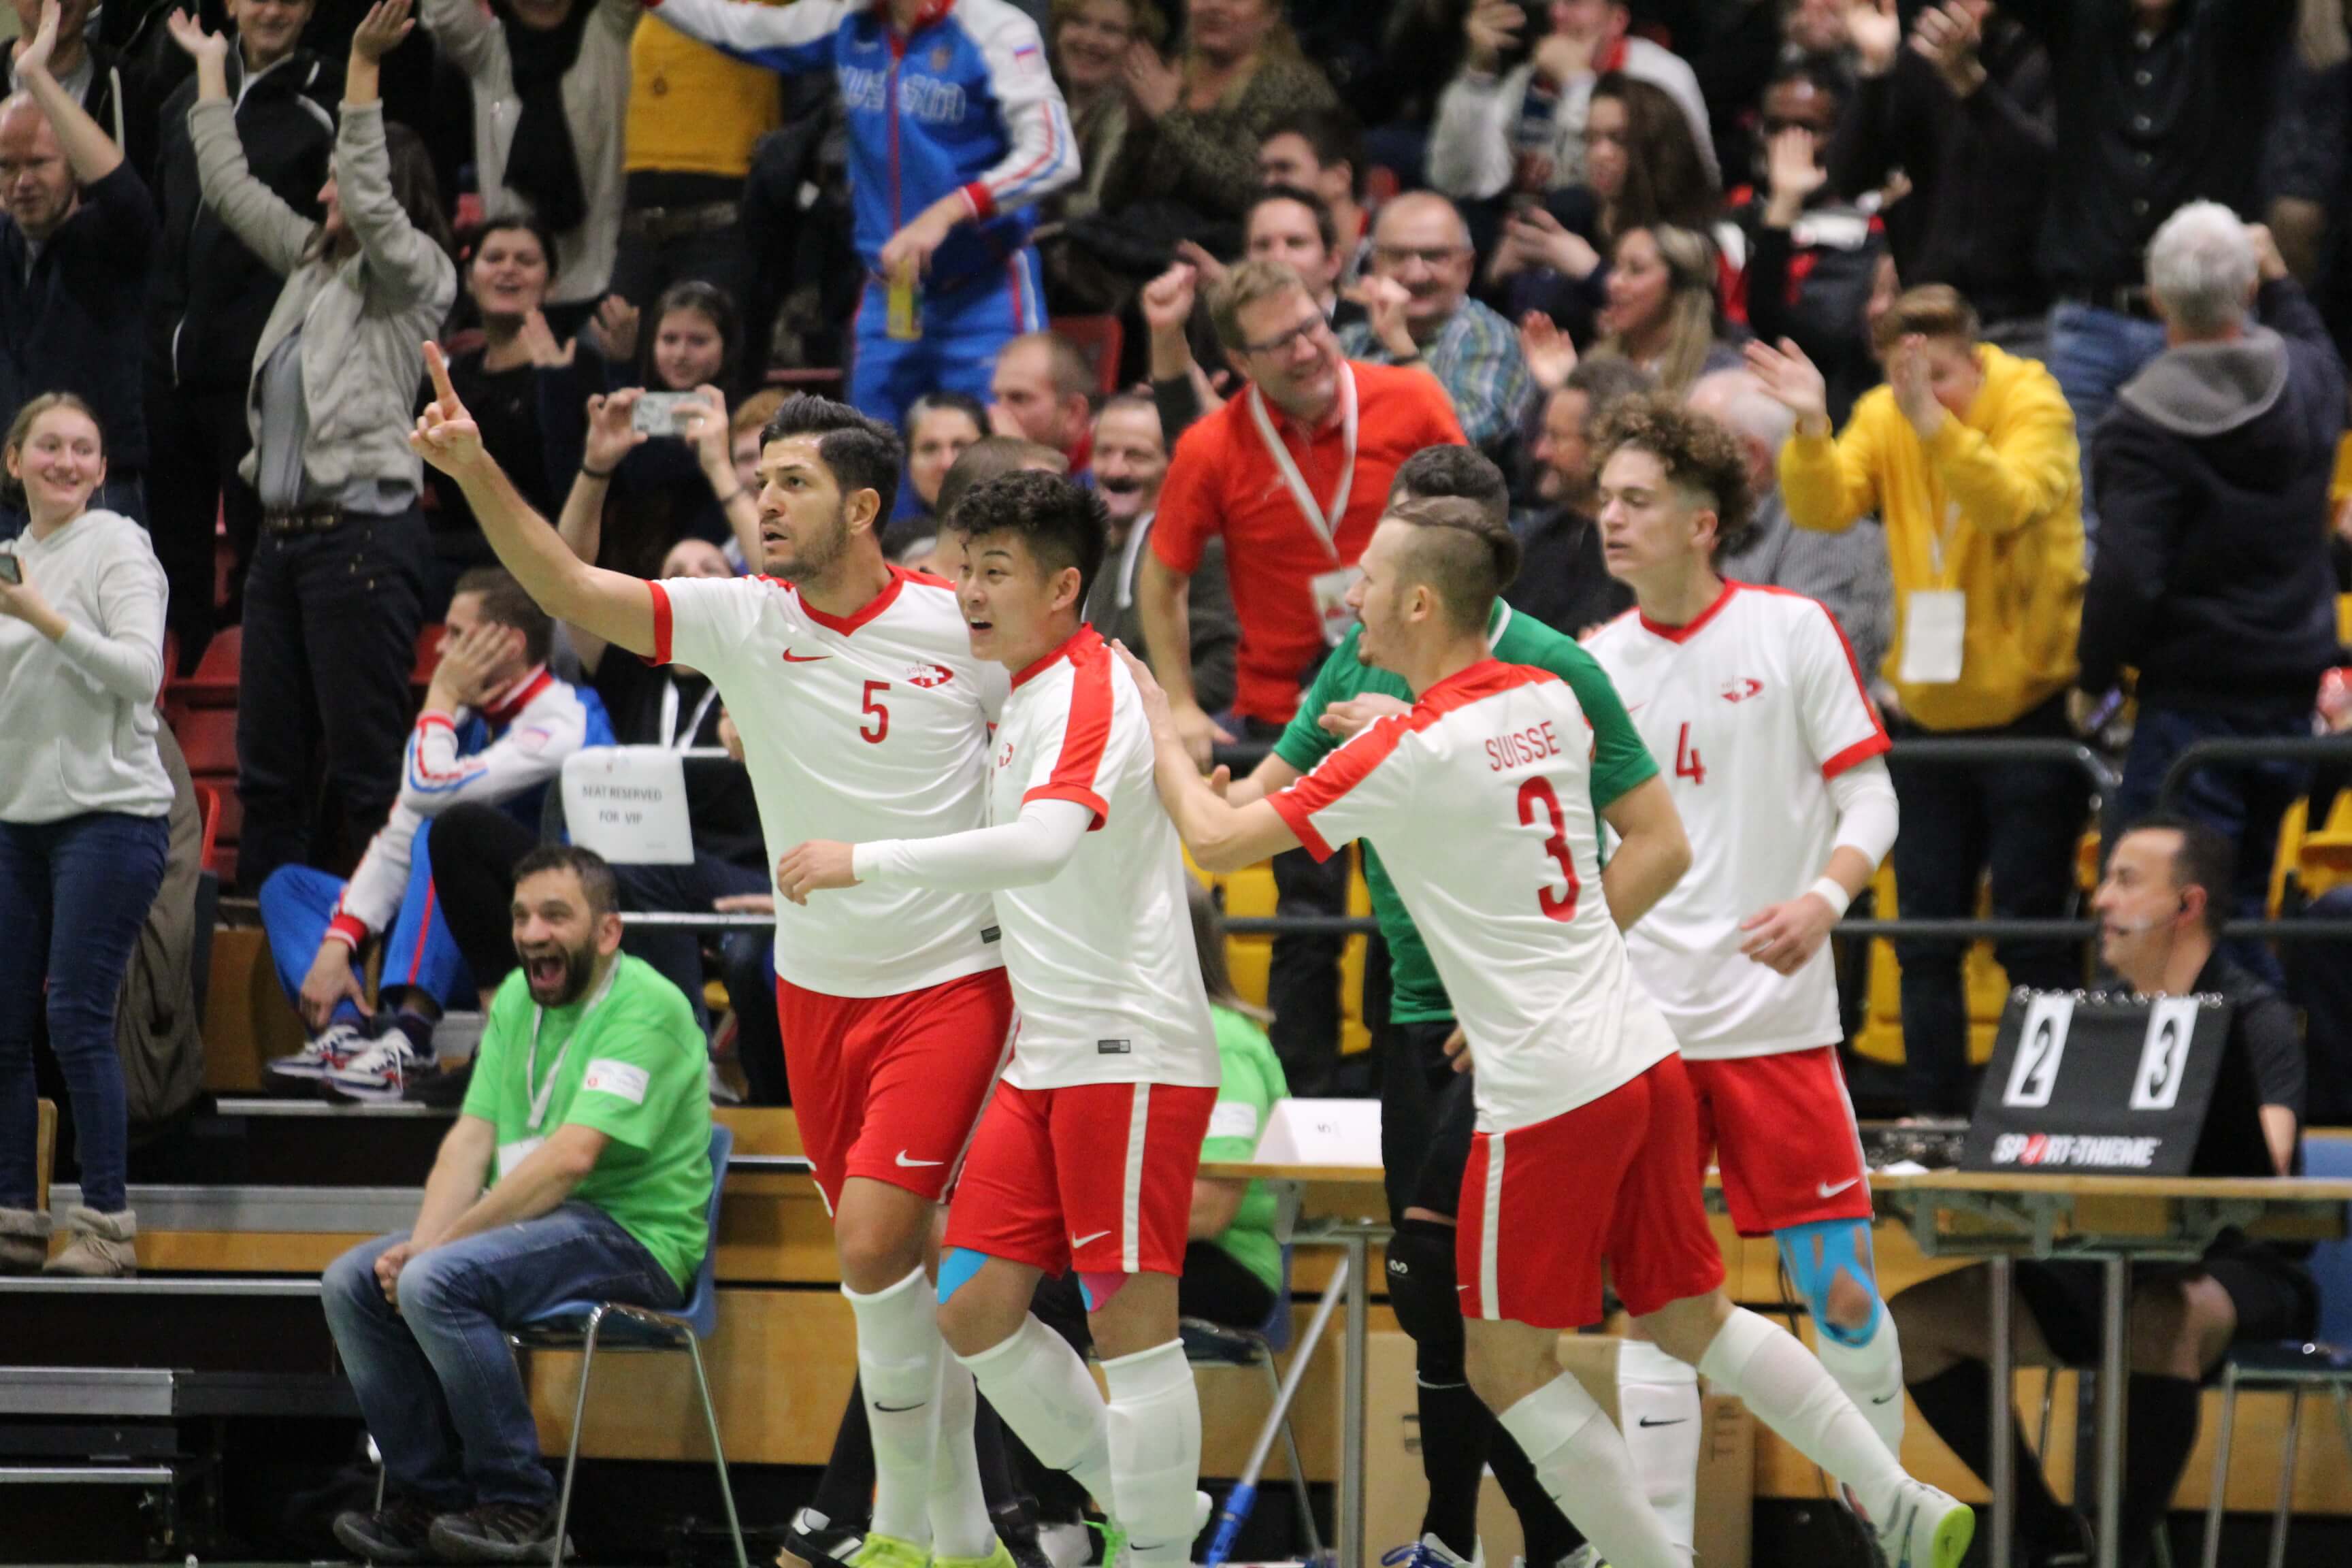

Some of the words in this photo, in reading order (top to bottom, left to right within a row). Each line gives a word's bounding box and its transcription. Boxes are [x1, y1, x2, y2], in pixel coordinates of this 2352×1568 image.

[860, 680, 890, 744] 5
[1486, 721, 1561, 771] SUISSE
[1676, 721, 1707, 785] 4
[583, 784, 606, 798] SEAT
[610, 785, 662, 801] RESERVED
[600, 811, 619, 823] FOR
[625, 811, 643, 825] VIP
[1517, 775, 1581, 922] 3
[2020, 1016, 2052, 1094] 2
[2150, 1017, 2176, 1098] 3
[1991, 1132, 2158, 1167] SPORT-THIEME
